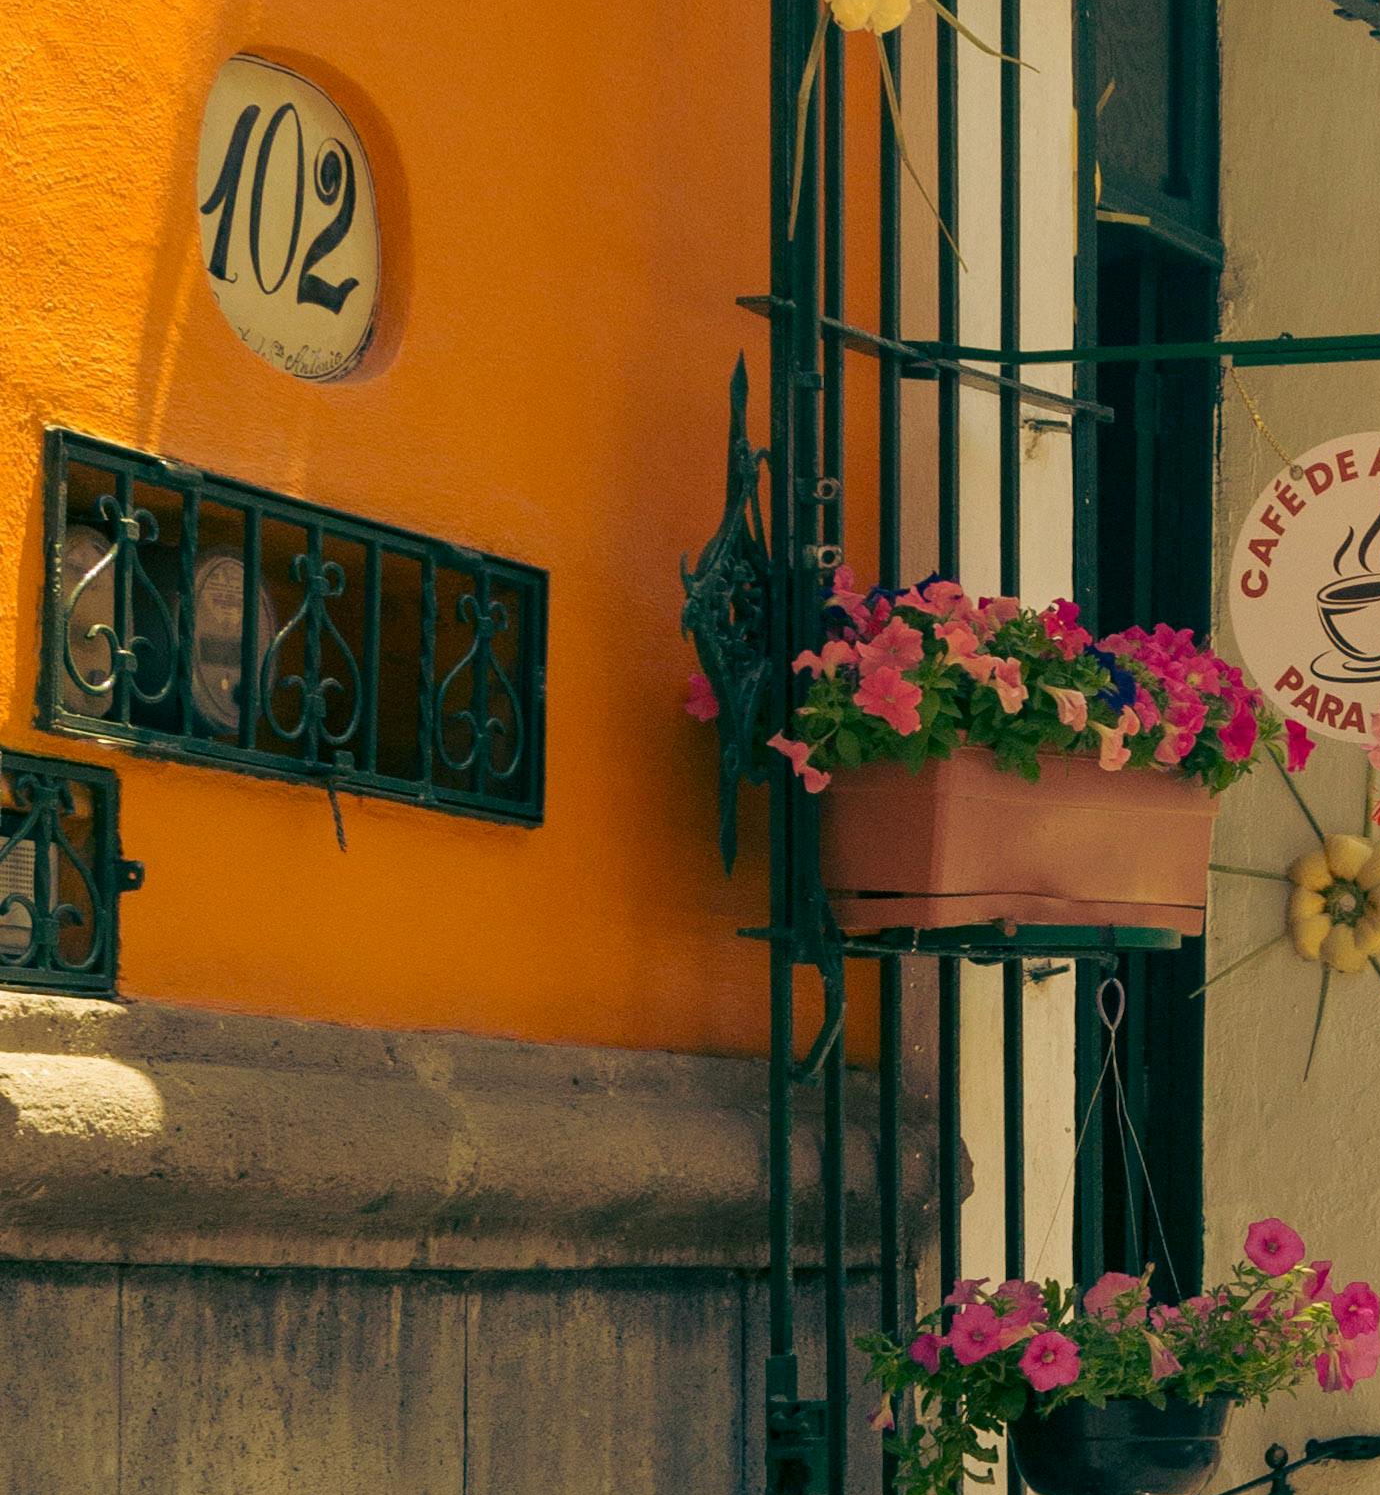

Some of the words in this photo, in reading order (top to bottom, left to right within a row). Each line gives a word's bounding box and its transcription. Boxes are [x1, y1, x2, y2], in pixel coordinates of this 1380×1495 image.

[200, 102, 360, 316] 102
[1241, 479, 1307, 598] CAFÉ
[1304, 449, 1359, 496] DE
[1274, 665, 1367, 734] PARA
